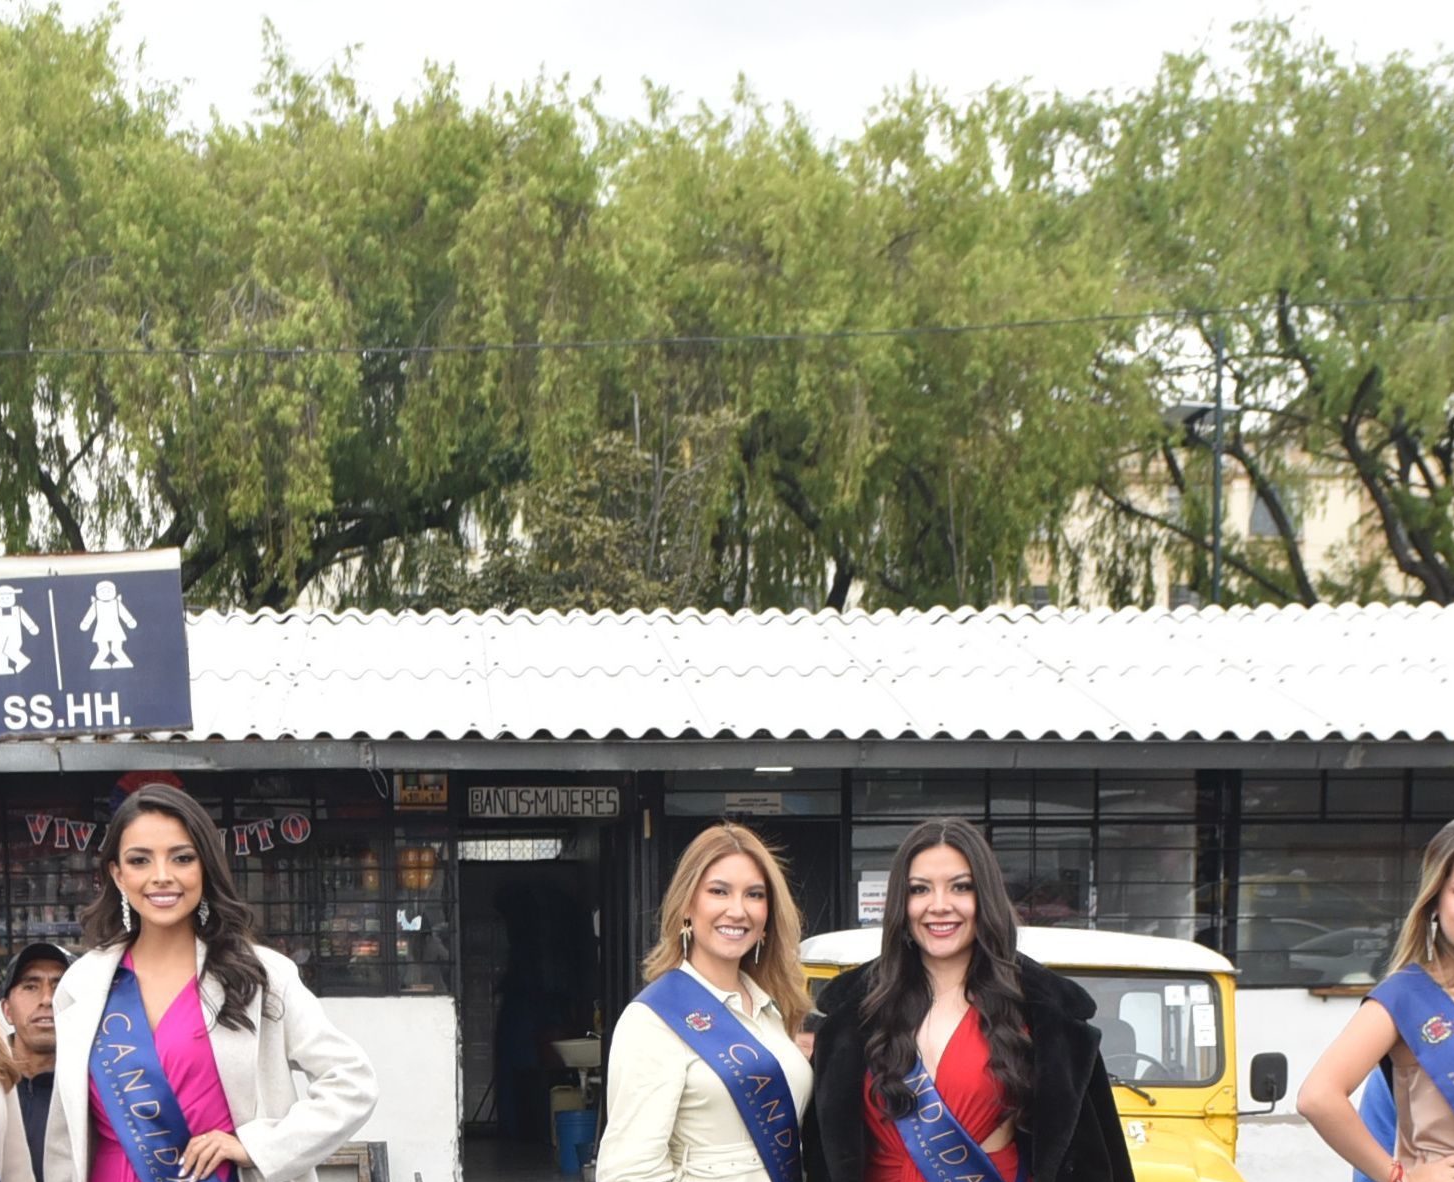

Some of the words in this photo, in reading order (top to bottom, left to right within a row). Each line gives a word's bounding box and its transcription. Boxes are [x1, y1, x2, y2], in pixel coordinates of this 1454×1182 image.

[4, 692, 131, 730] SS.HH.
[25, 814, 110, 852] VIV
[217, 813, 311, 856] ITO
[729, 1043, 799, 1166] CANDI
